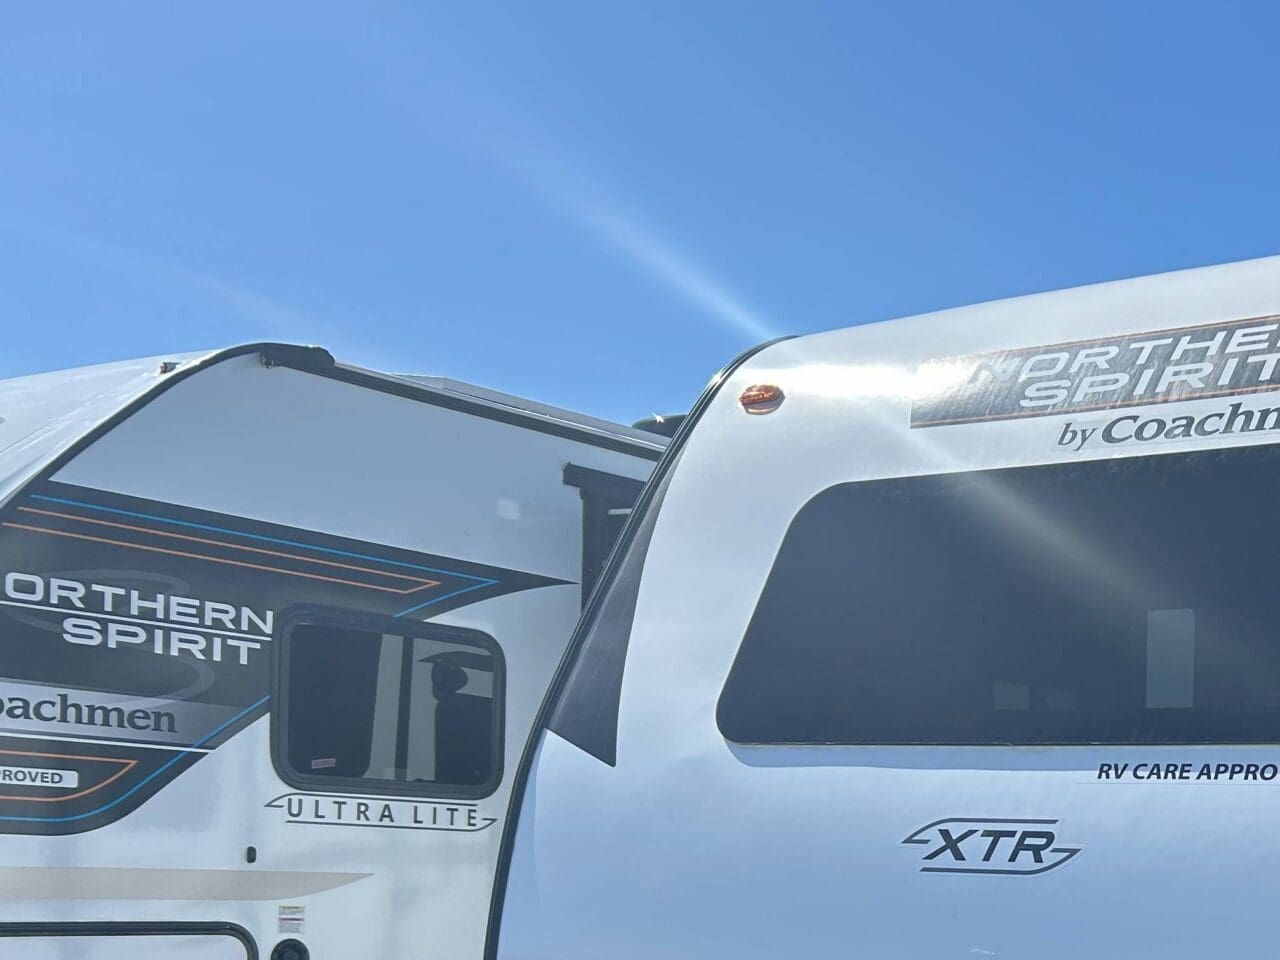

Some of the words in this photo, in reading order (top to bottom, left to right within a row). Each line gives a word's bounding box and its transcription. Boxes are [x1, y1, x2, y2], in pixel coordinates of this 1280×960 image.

[1057, 423, 1097, 451] by
[4, 572, 274, 635] ORTHERN
[62, 617, 261, 665] SPIRIT
[0, 693, 177, 733] achmen
[0, 769, 63, 784] ROVED
[1097, 763, 1129, 780] RV
[1132, 763, 1193, 780] CARE
[287, 798, 395, 823] ULTRA
[413, 805, 478, 827] LITE
[922, 828, 1056, 864] XTR
